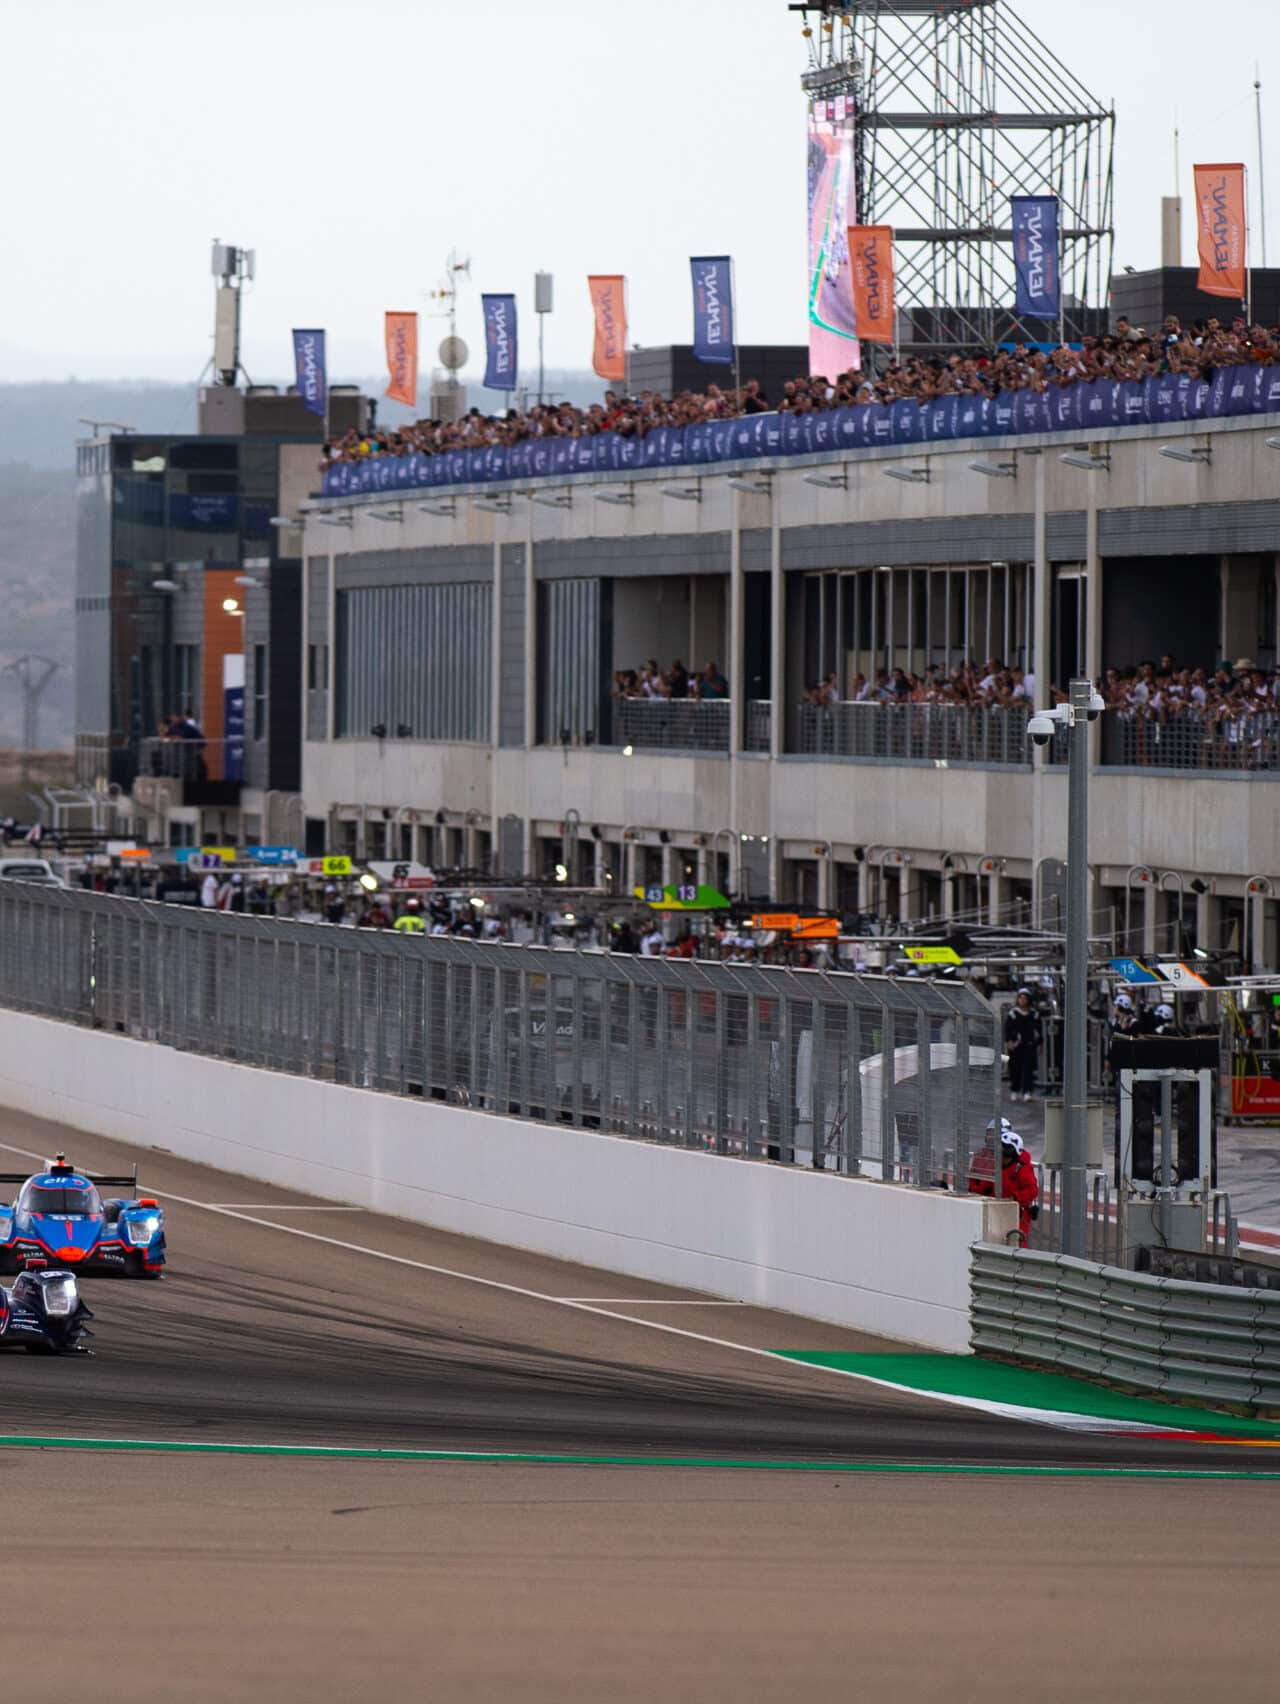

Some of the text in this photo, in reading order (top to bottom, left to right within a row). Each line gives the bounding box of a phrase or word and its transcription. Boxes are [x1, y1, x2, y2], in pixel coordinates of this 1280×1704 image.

[327, 858, 347, 872] 66
[646, 889, 663, 901] 43
[678, 885, 697, 900] 13
[1122, 963, 1135, 974] 15
[1173, 968, 1181, 980] 5
[43, 1176, 68, 1185] elf
